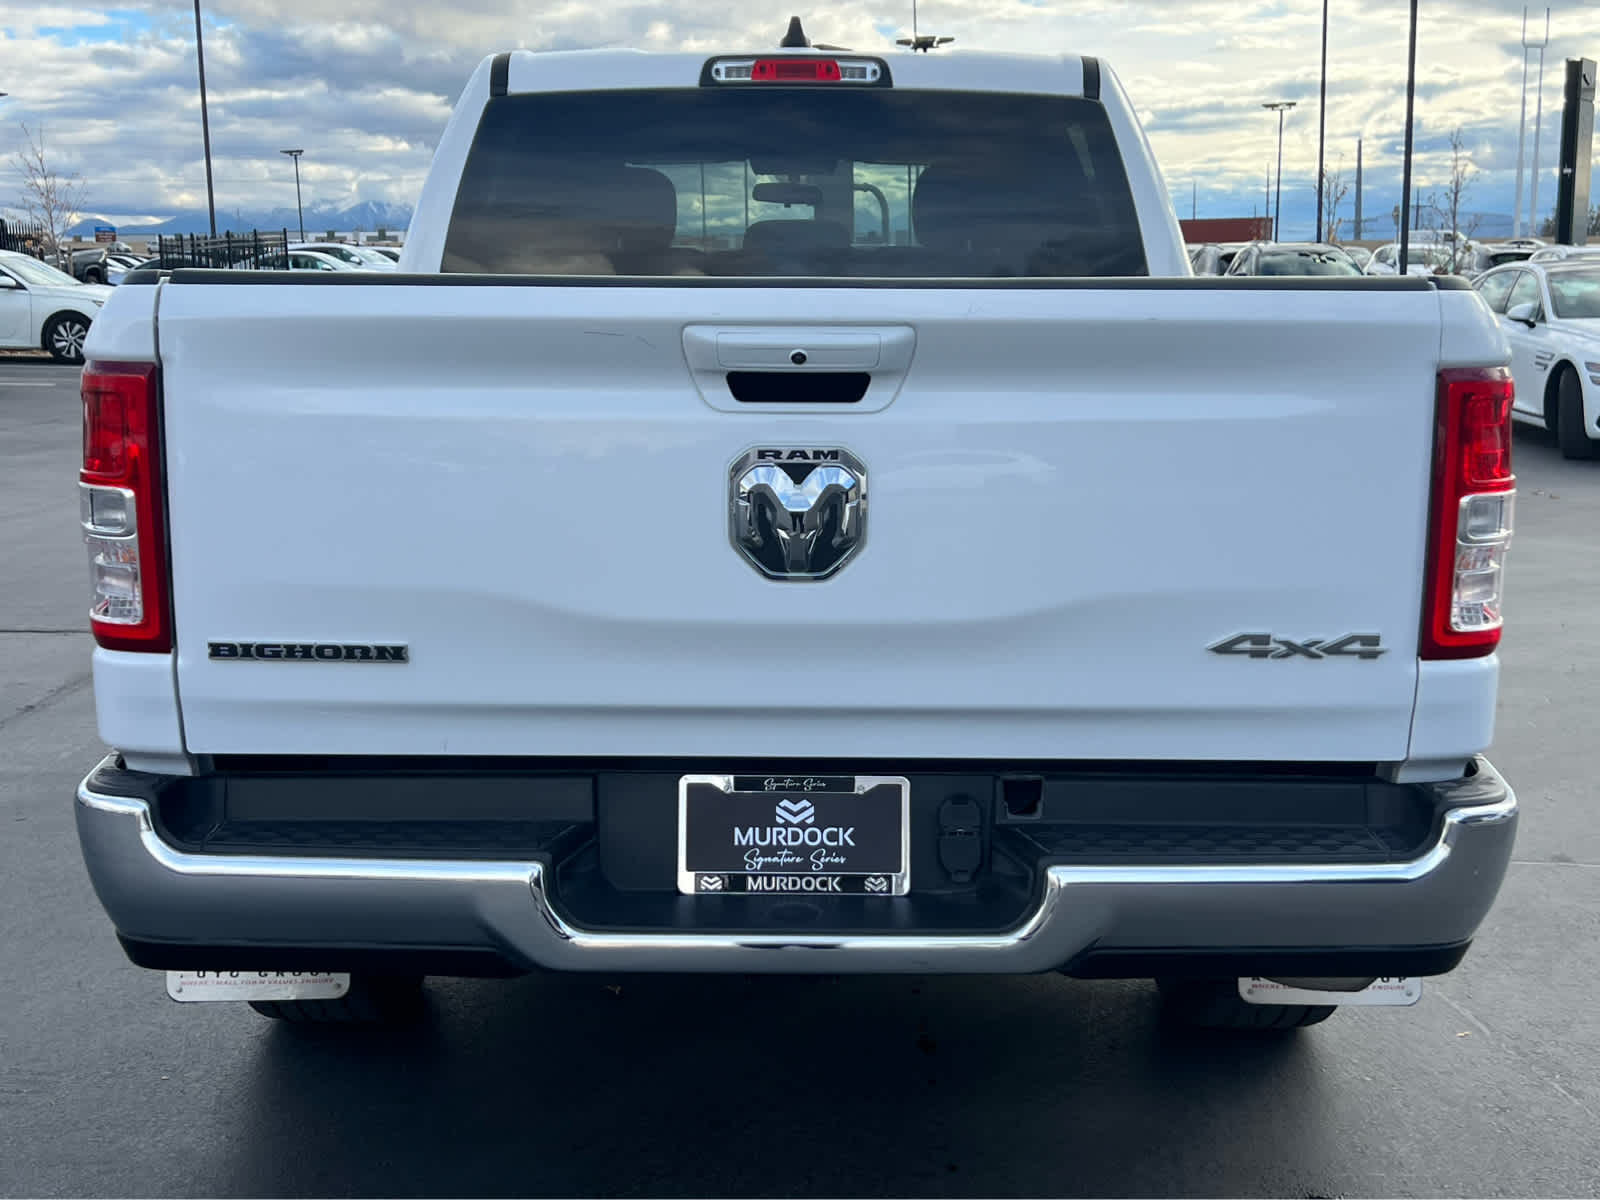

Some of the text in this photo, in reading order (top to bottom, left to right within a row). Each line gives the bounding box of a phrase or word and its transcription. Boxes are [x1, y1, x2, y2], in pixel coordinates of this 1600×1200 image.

[757, 449, 839, 460] RAM
[207, 642, 409, 662] BIGHORN
[734, 827, 855, 846] MURDOCK
[743, 848, 846, 871] Signature Series
[747, 876, 842, 892] MURDOCK
